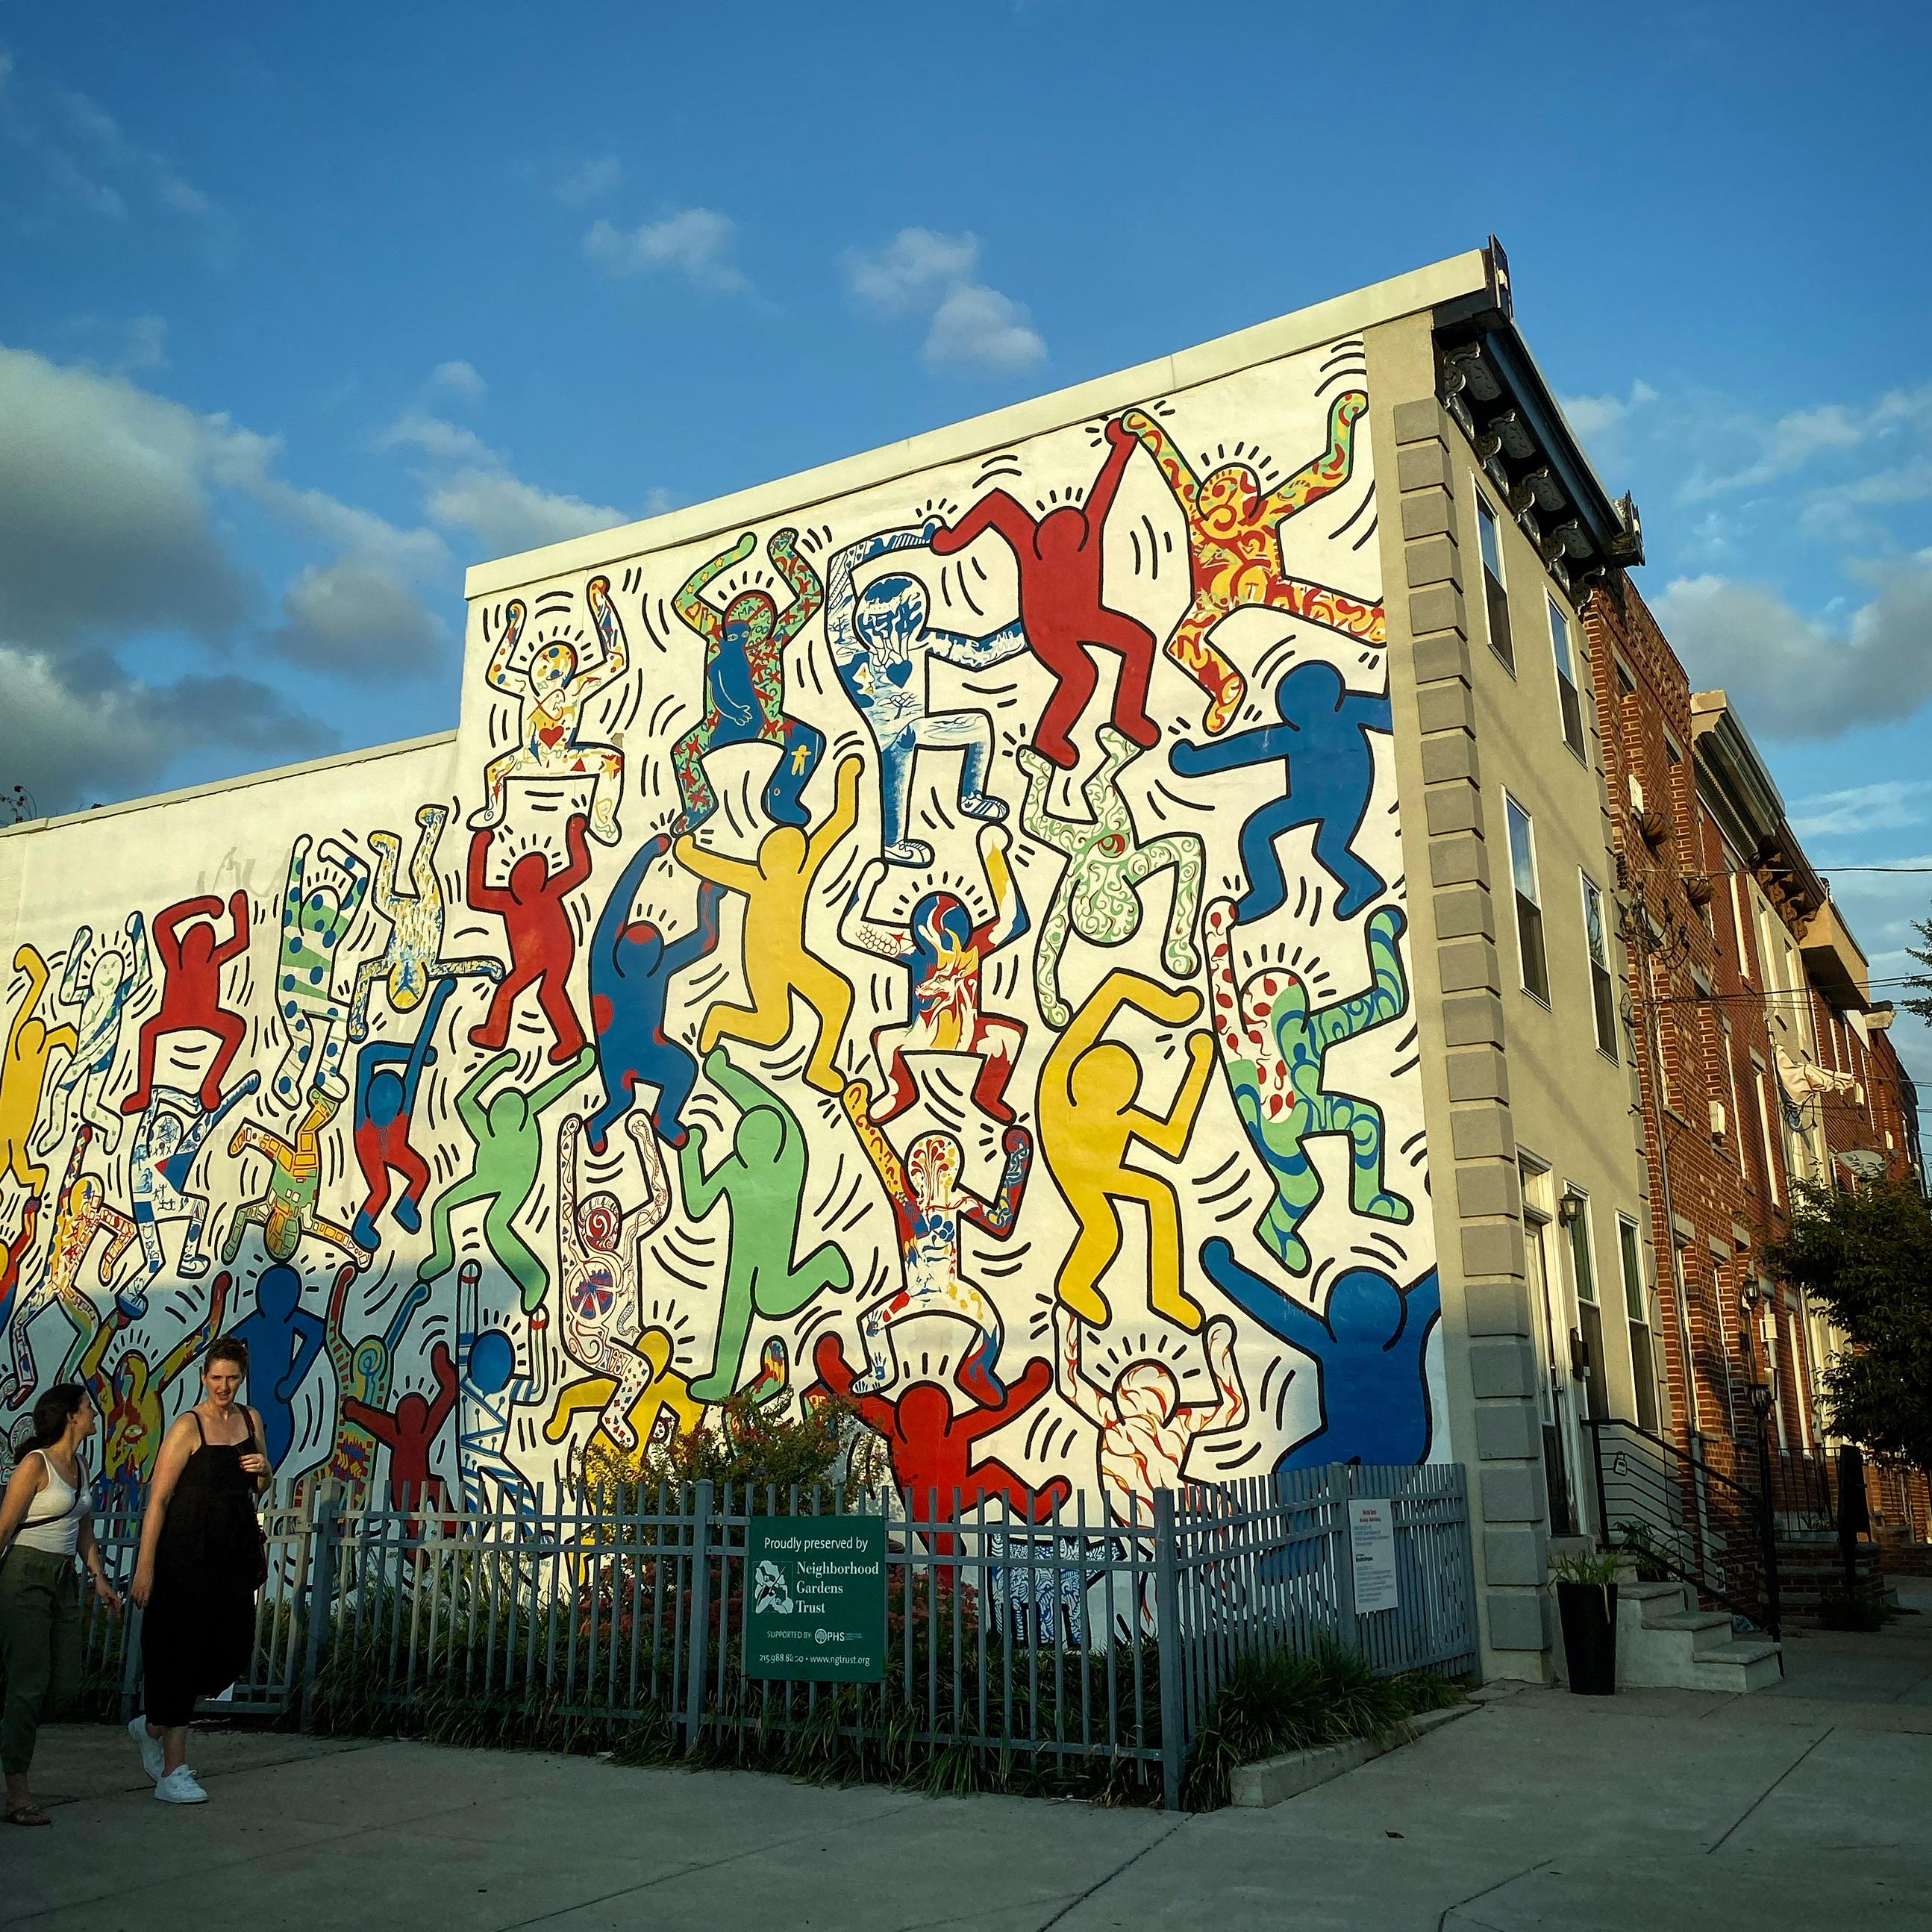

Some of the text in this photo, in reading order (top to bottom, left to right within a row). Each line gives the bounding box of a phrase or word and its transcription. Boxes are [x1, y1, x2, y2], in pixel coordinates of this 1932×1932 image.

[764, 1536, 869, 1553] Proudly preserved by
[796, 1561, 879, 1578] Neighborhood
[796, 1581, 843, 1594] Gardens
[795, 1600, 826, 1613] Trust
[766, 1631, 802, 1639] SUPPORTED
[828, 1632, 845, 1641] PHS
[810, 1655, 870, 1666] www.ngtrust.org
